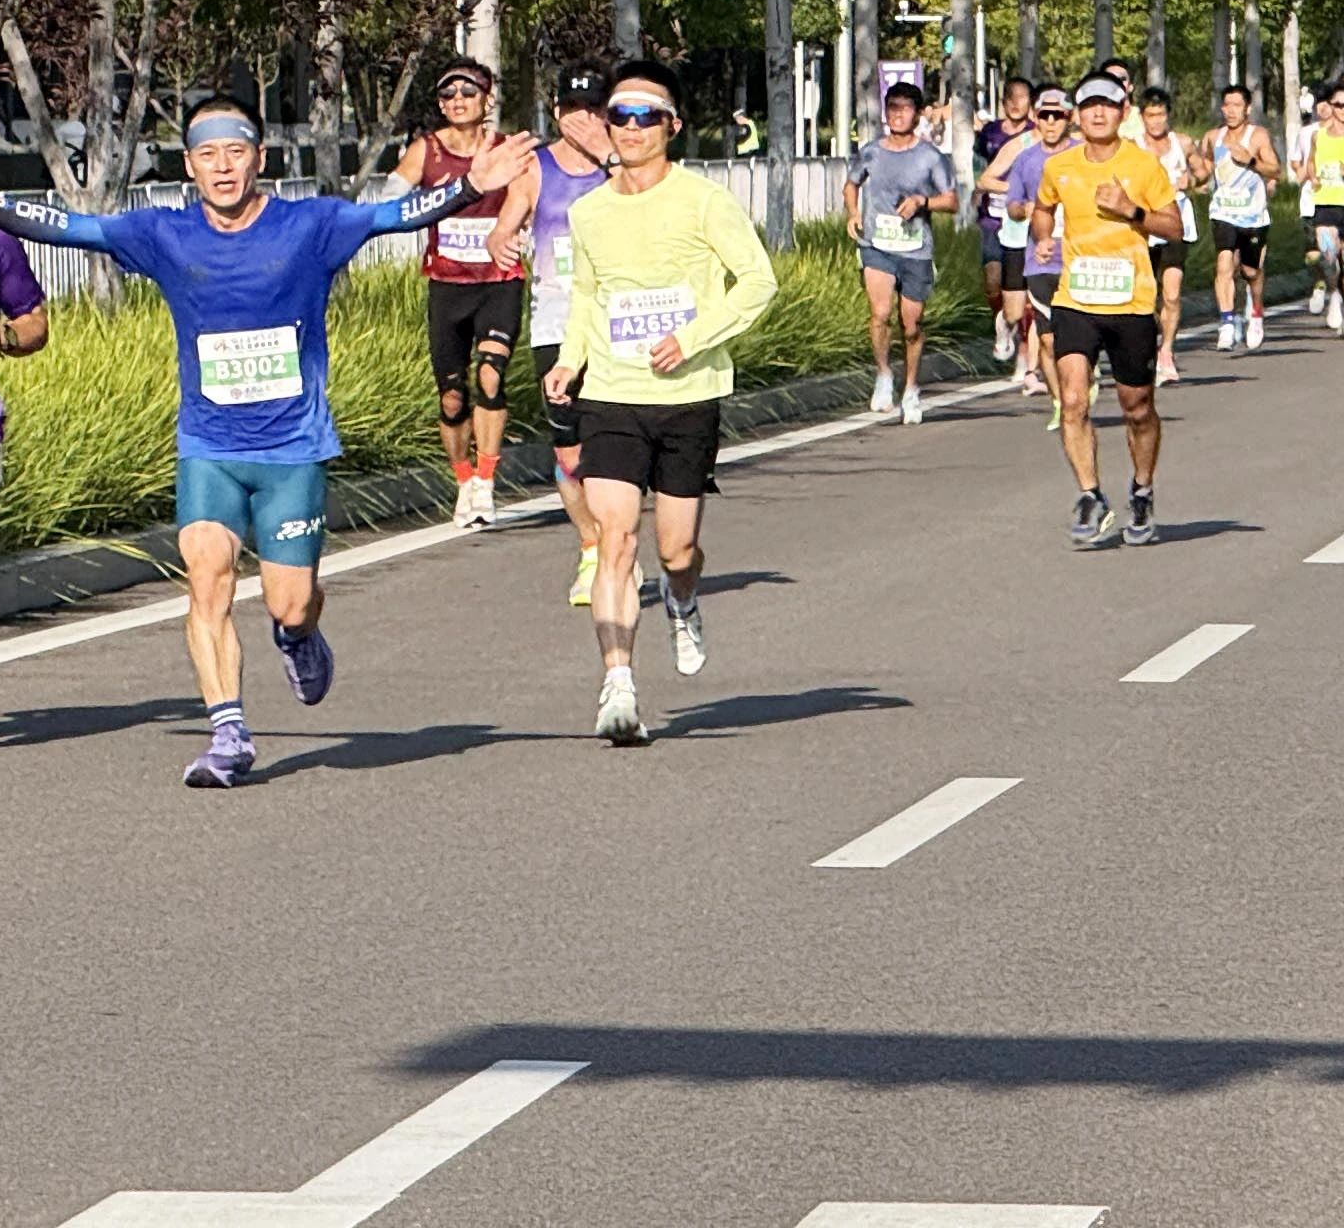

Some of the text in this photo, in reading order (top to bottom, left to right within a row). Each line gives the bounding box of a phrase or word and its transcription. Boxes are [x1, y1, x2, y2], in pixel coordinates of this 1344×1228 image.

[448, 234, 486, 247] A017
[621, 311, 688, 337] A2655
[215, 354, 287, 380] B3002
